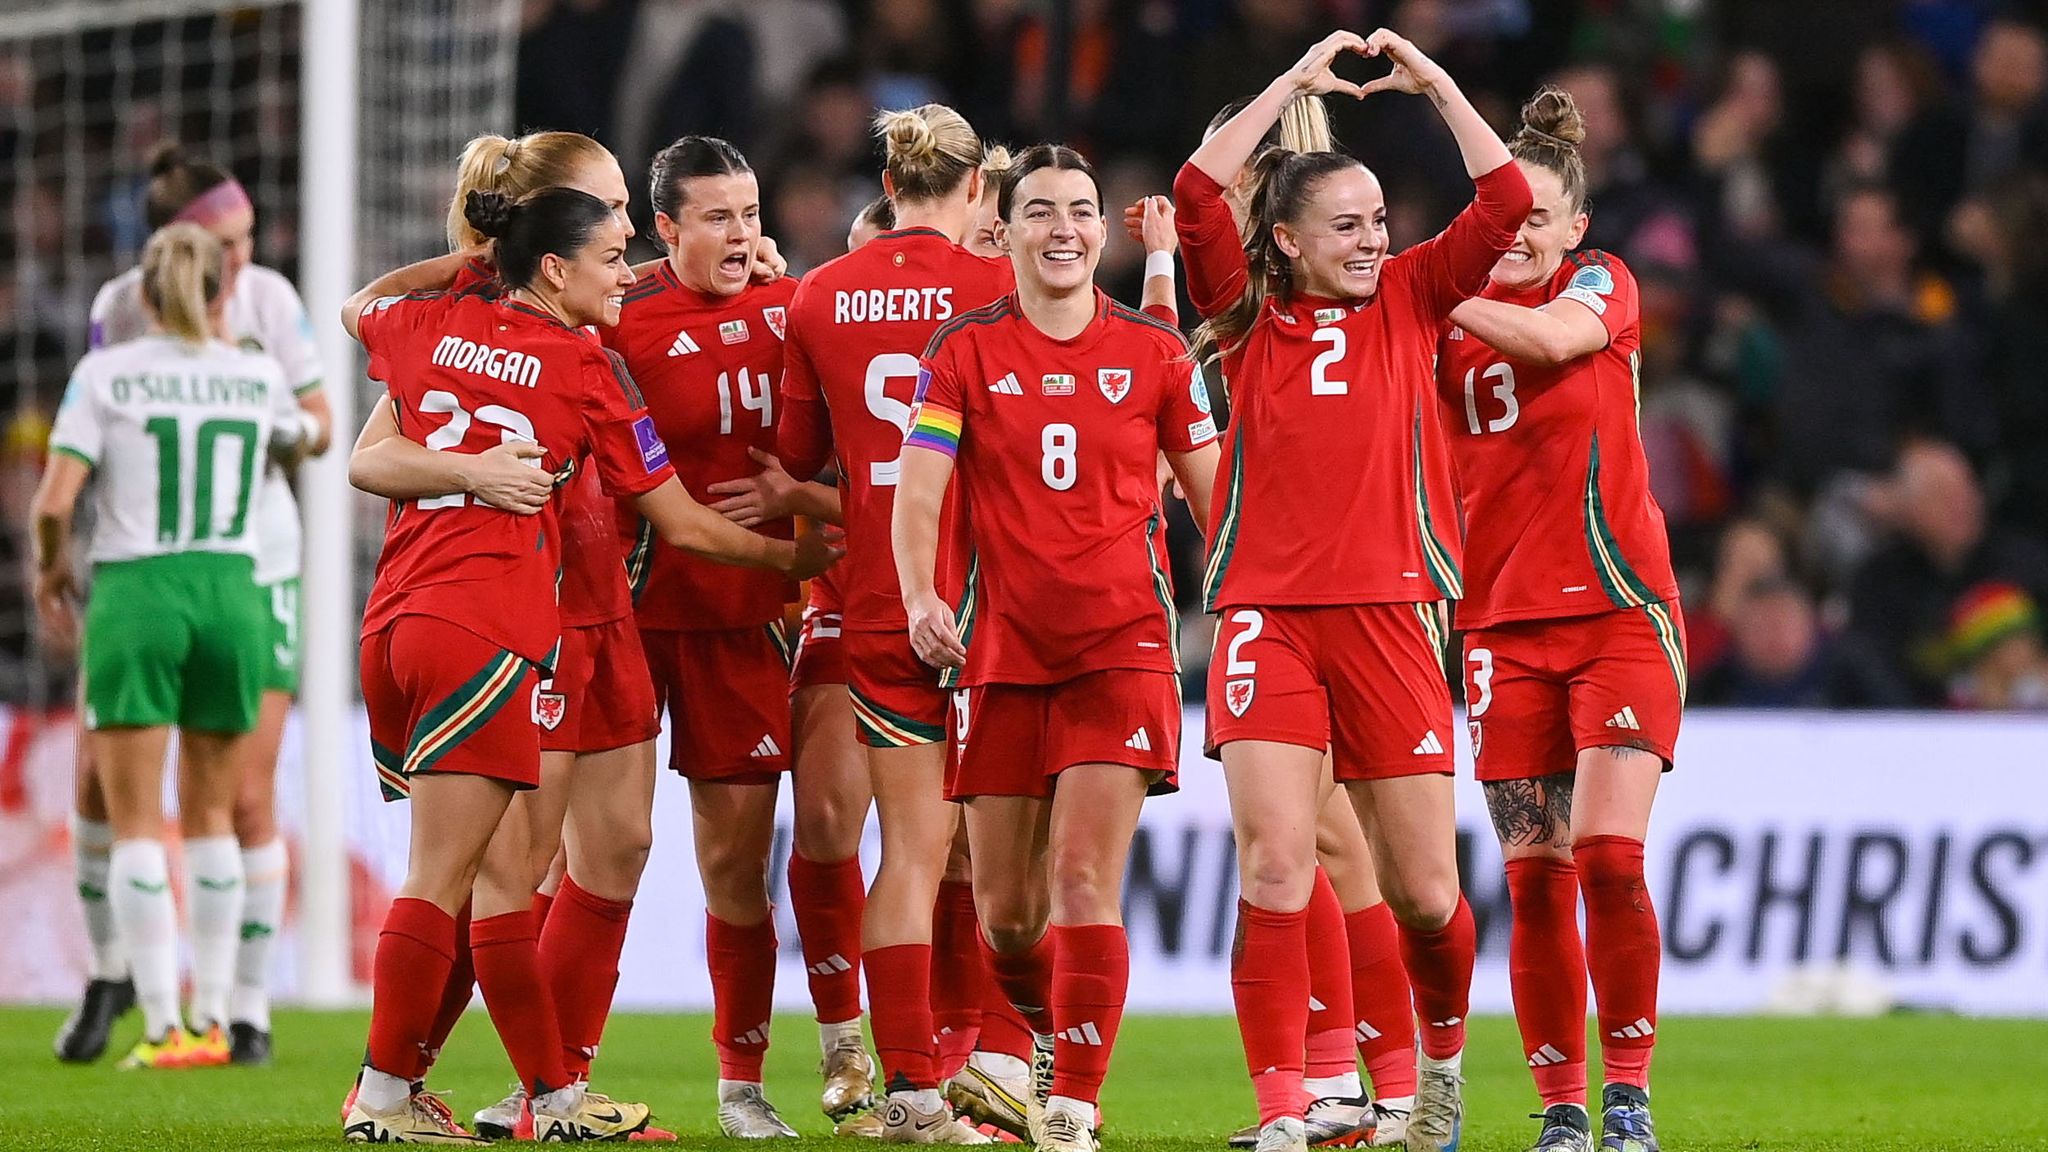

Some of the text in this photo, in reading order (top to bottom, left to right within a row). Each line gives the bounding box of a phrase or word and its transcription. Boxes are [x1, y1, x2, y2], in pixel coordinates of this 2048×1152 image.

[835, 288, 953, 324] ROBERTS
[432, 335, 542, 388] MORGAN
[1311, 327, 1348, 396] 2
[717, 366, 772, 434] 14
[865, 353, 923, 486] 5
[1464, 362, 1519, 435] 13
[146, 416, 259, 543] 10
[1042, 423, 1077, 490] 8
[1226, 610, 1264, 676] 2
[1665, 826, 2048, 968] CHRIS
